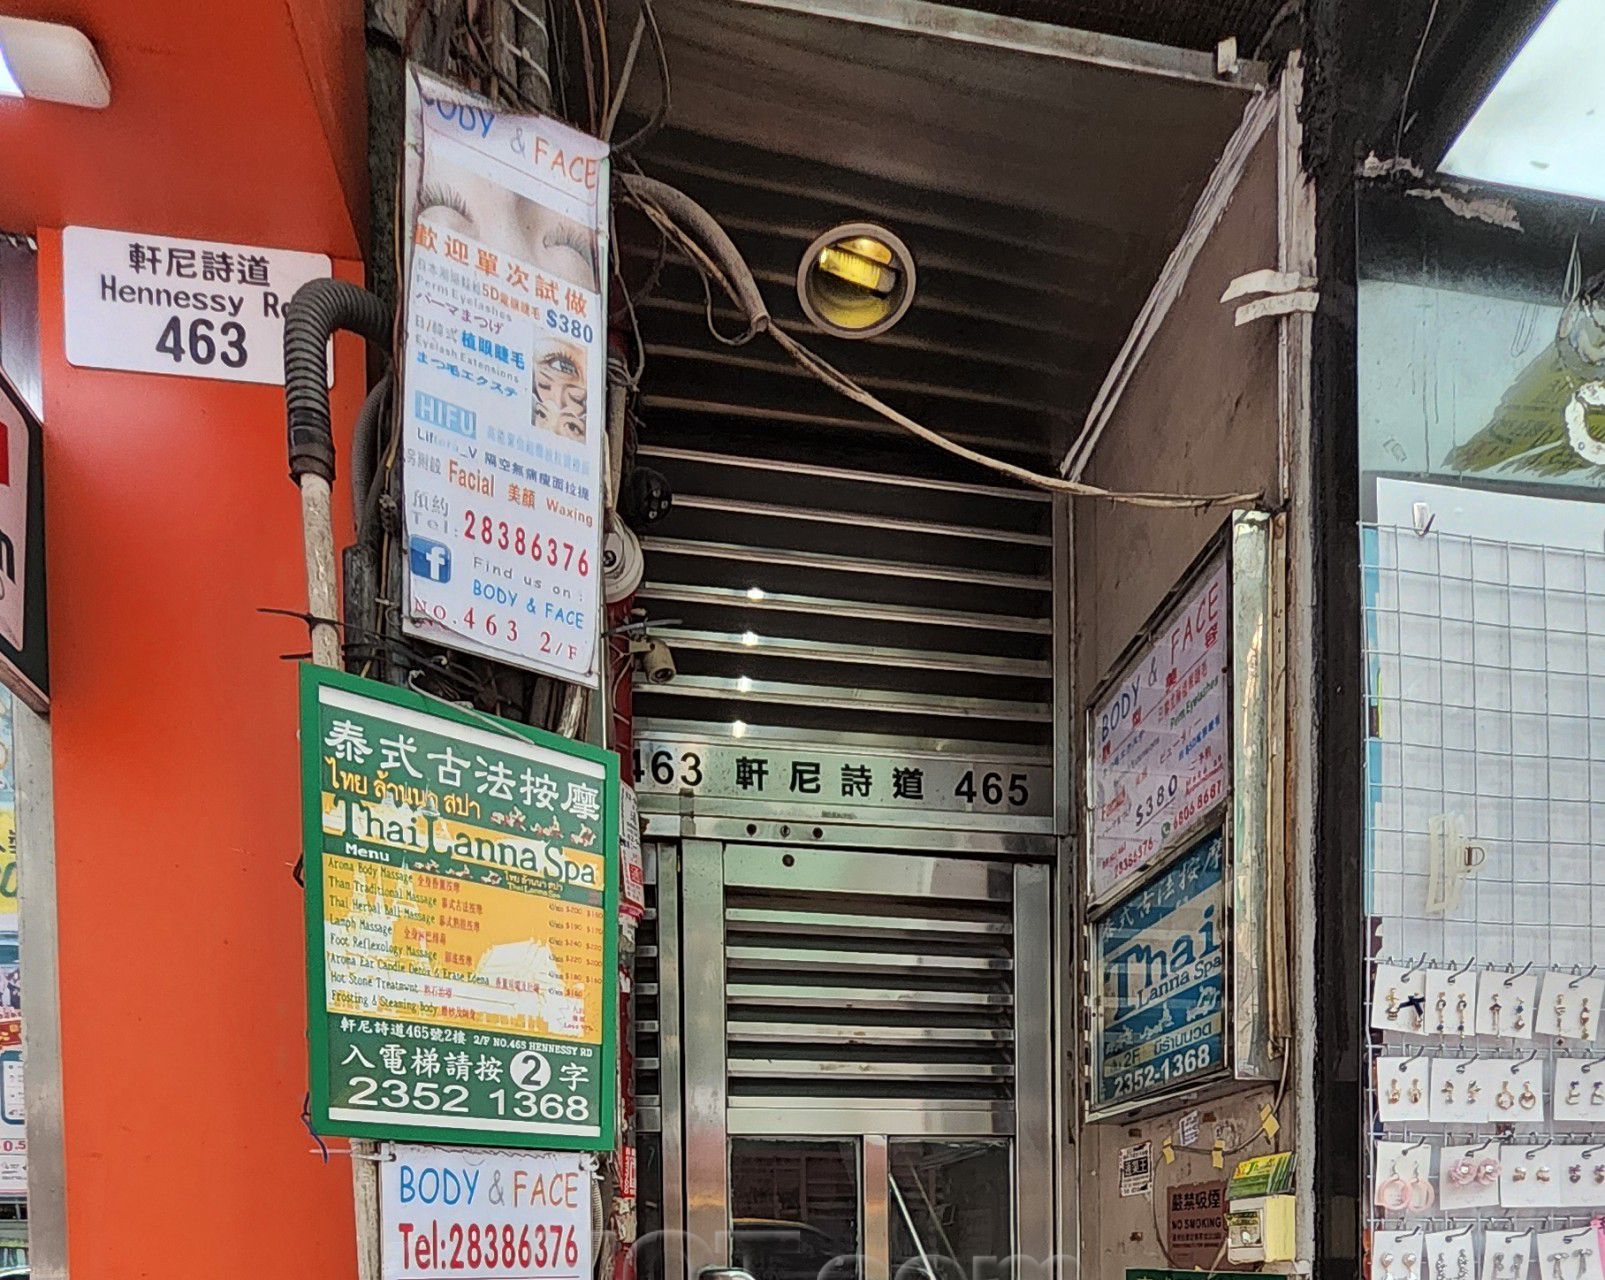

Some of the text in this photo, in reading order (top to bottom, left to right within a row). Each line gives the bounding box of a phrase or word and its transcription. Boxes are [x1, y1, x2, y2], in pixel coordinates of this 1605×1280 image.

[425, 99, 597, 189] ODY & FACE
[128, 242, 271, 287] 軒尼詩道
[100, 274, 244, 318] Hennessy
[155, 315, 248, 368] 463
[546, 309, 594, 343] $380
[419, 394, 475, 436] HIFU
[449, 458, 495, 498] Facial
[546, 497, 593, 527] Waxing
[464, 509, 589, 577] 28386376
[473, 556, 513, 580] Find
[523, 575, 542, 590] us
[472, 579, 584, 630] BODY & FACE
[540, 631, 577, 660] 2/F
[1102, 675, 1140, 742] BODY
[1171, 582, 1218, 665] FACE
[324, 719, 601, 822] 泰式古法按摩
[324, 755, 368, 795] ไทย
[443, 792, 481, 820] สปา
[735, 756, 925, 800] 軒尼詩道
[954, 770, 1029, 807] 465
[333, 793, 418, 848] Thai
[427, 813, 537, 872] Lanna
[543, 840, 595, 886] Spa
[345, 842, 390, 862] Menu
[354, 881, 402, 899] Traditional
[406, 890, 437, 907] Massage
[358, 864, 377, 879] Body
[380, 868, 413, 884] Massage
[352, 898, 381, 914] Herbal
[404, 907, 435, 925] Massage
[360, 918, 393, 936] Massage
[330, 933, 350, 947] Foot
[353, 936, 403, 957] Reflexology
[406, 945, 437, 962] Massage
[1104, 903, 1220, 1021] Thai
[330, 972, 347, 984] Hot
[349, 973, 373, 987] Stone
[376, 977, 419, 993] Treatment
[331, 990, 369, 1008] Frosting
[379, 995, 417, 1013] Steaming
[1137, 954, 1223, 1010] Lanna Spa
[340, 1017, 592, 1057] 軒尼詩道465號2樓 2/F NO.465 HENNESSY RD
[341, 1044, 503, 1083] 入電梯請按
[559, 1062, 590, 1092] 字
[1115, 1044, 1211, 1098] 2352-1368
[348, 1076, 589, 1121] 2352 1368
[400, 1165, 480, 1206] BODY
[488, 1170, 505, 1206] &
[513, 1170, 579, 1208] FACE
[398, 1219, 579, 1270] Tel:28386376
[1172, 1217, 1221, 1229] NO SMOKING
